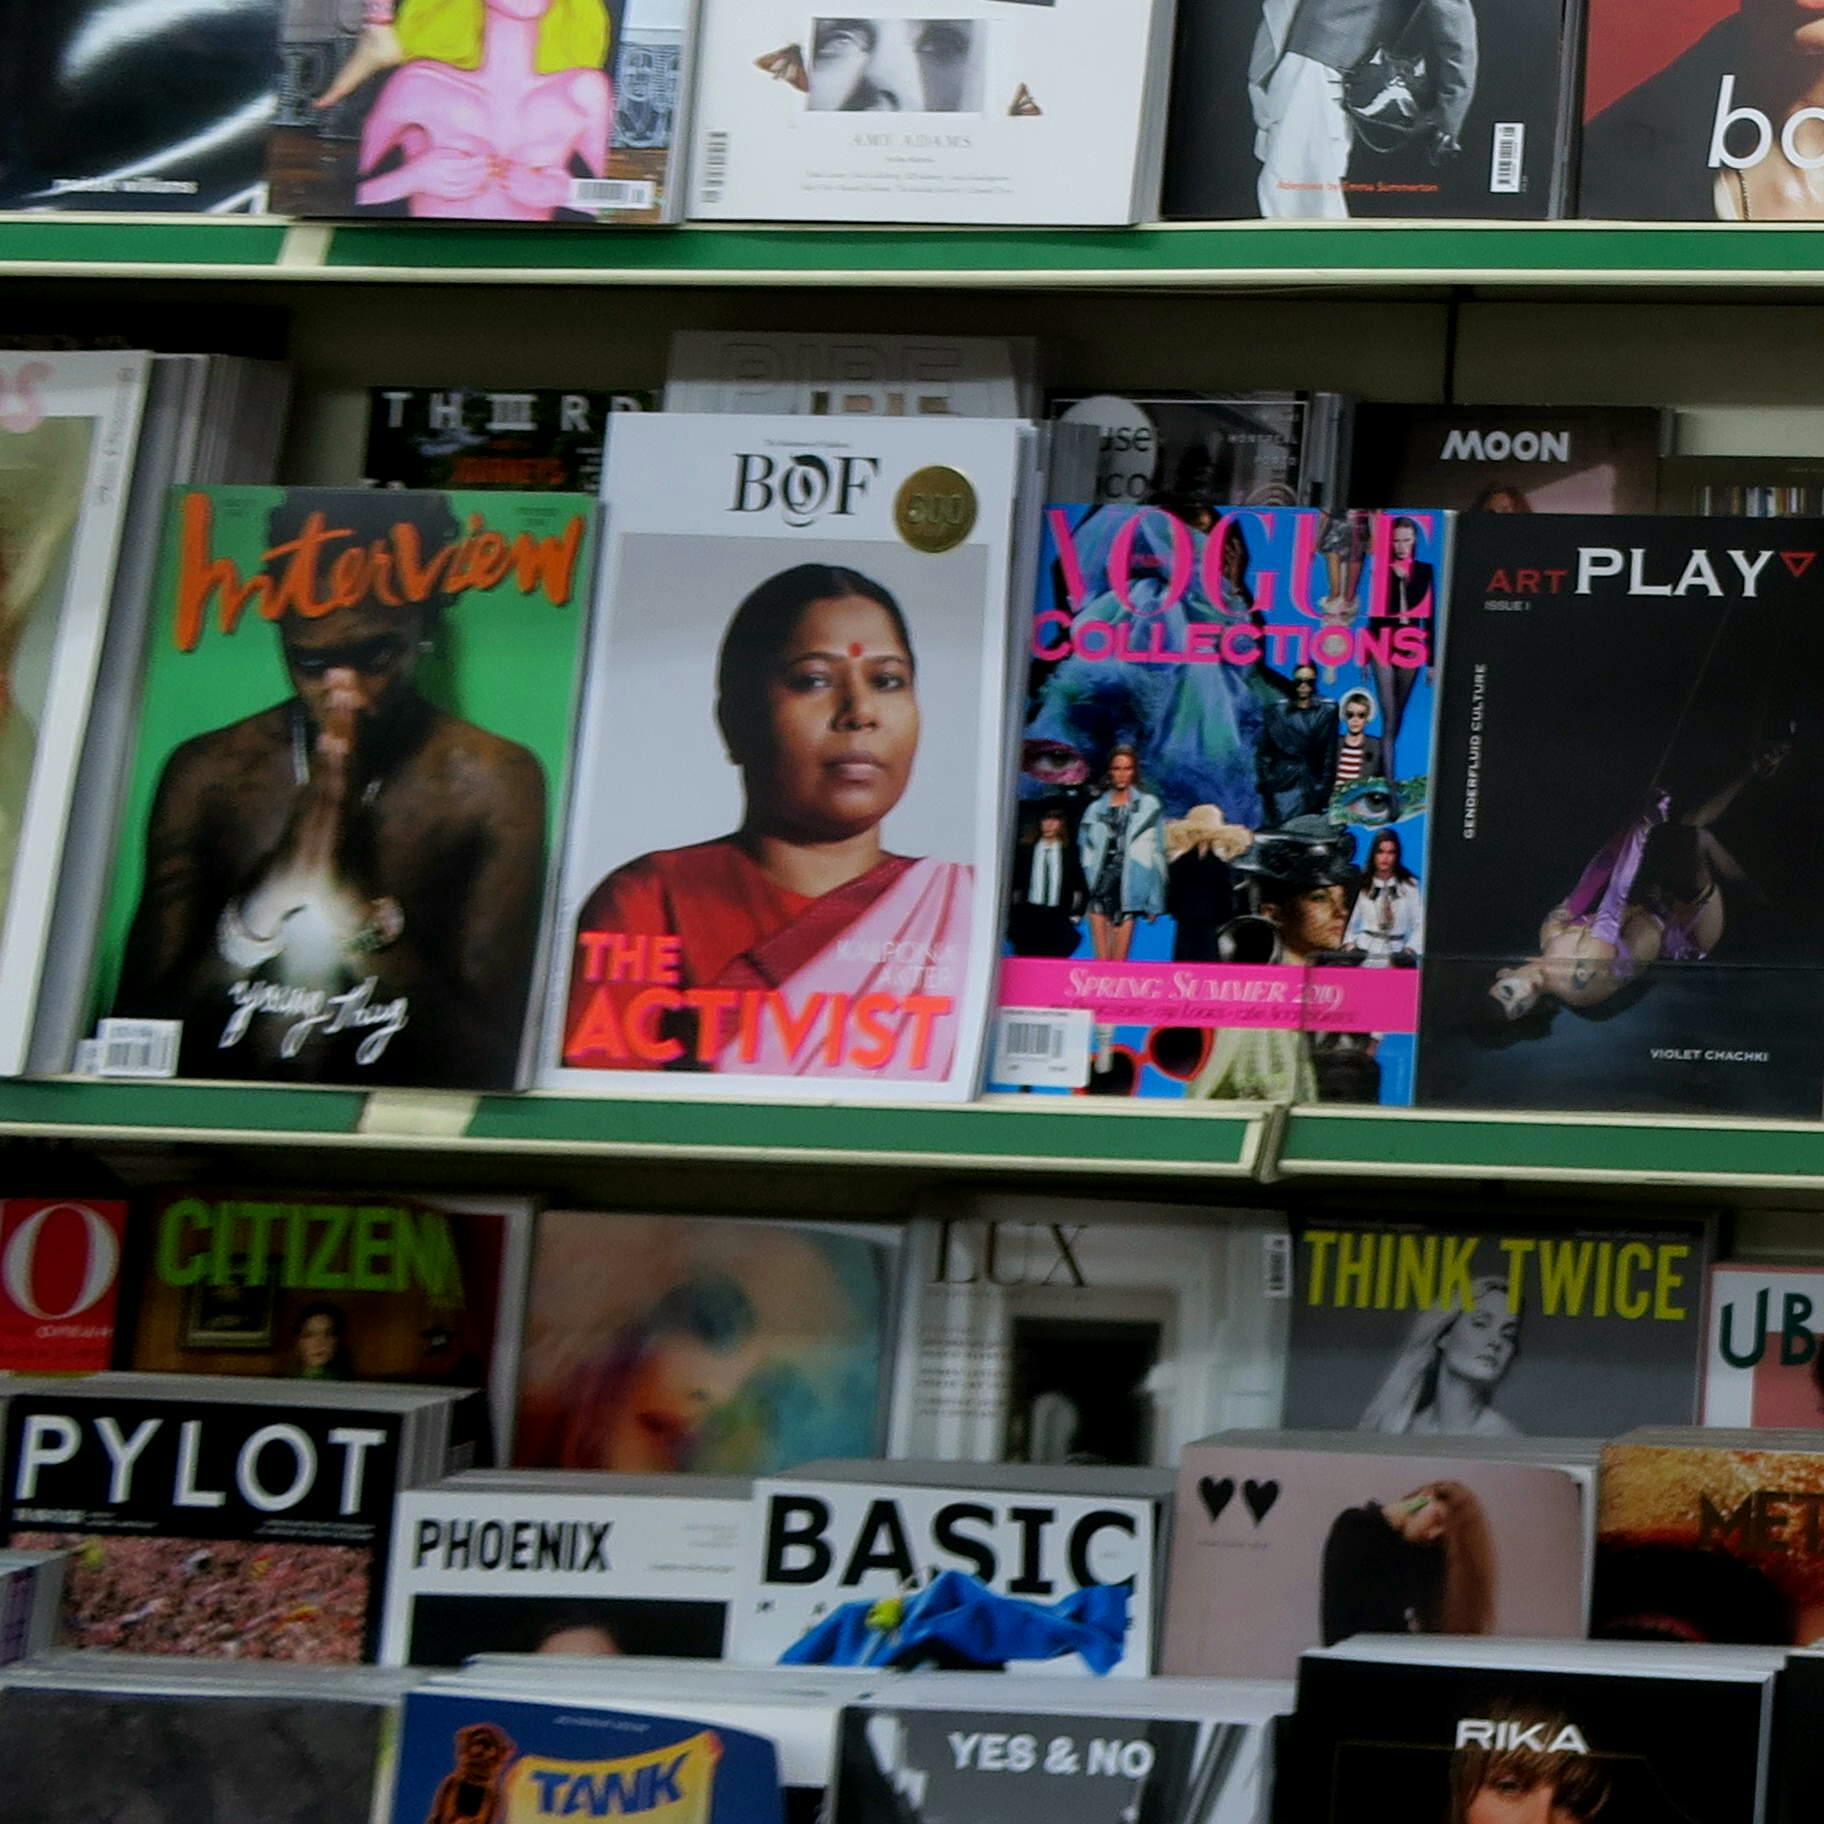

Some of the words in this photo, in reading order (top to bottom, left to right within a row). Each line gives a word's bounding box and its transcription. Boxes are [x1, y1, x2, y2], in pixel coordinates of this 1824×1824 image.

[1440, 429, 1570, 463] MOON
[173, 492, 586, 651] Interview
[1042, 506, 1435, 622] VOGUE
[1485, 568, 1568, 594] ART
[1576, 545, 1774, 599] PLAY
[1032, 613, 1429, 668] COLLECTIONS
[580, 932, 683, 984] THE
[571, 987, 953, 1068] ACTIVIST
[1650, 1047, 1703, 1060] VIOLET
[1705, 1048, 1769, 1063] CHACHKI
[1303, 1230, 1481, 1314] THINK
[1501, 1237, 1690, 1322] TWICE
[14, 1415, 388, 1516] PYLOT
[413, 1518, 614, 1574] PHOENIX
[763, 1495, 1139, 1596] BASIC
[949, 1733, 1039, 1774] YES
[1047, 1736, 1080, 1776] &
[1088, 1738, 1156, 1778] NO
[1454, 1719, 1590, 1756] RIKA
[526, 1754, 689, 1816] TANK
